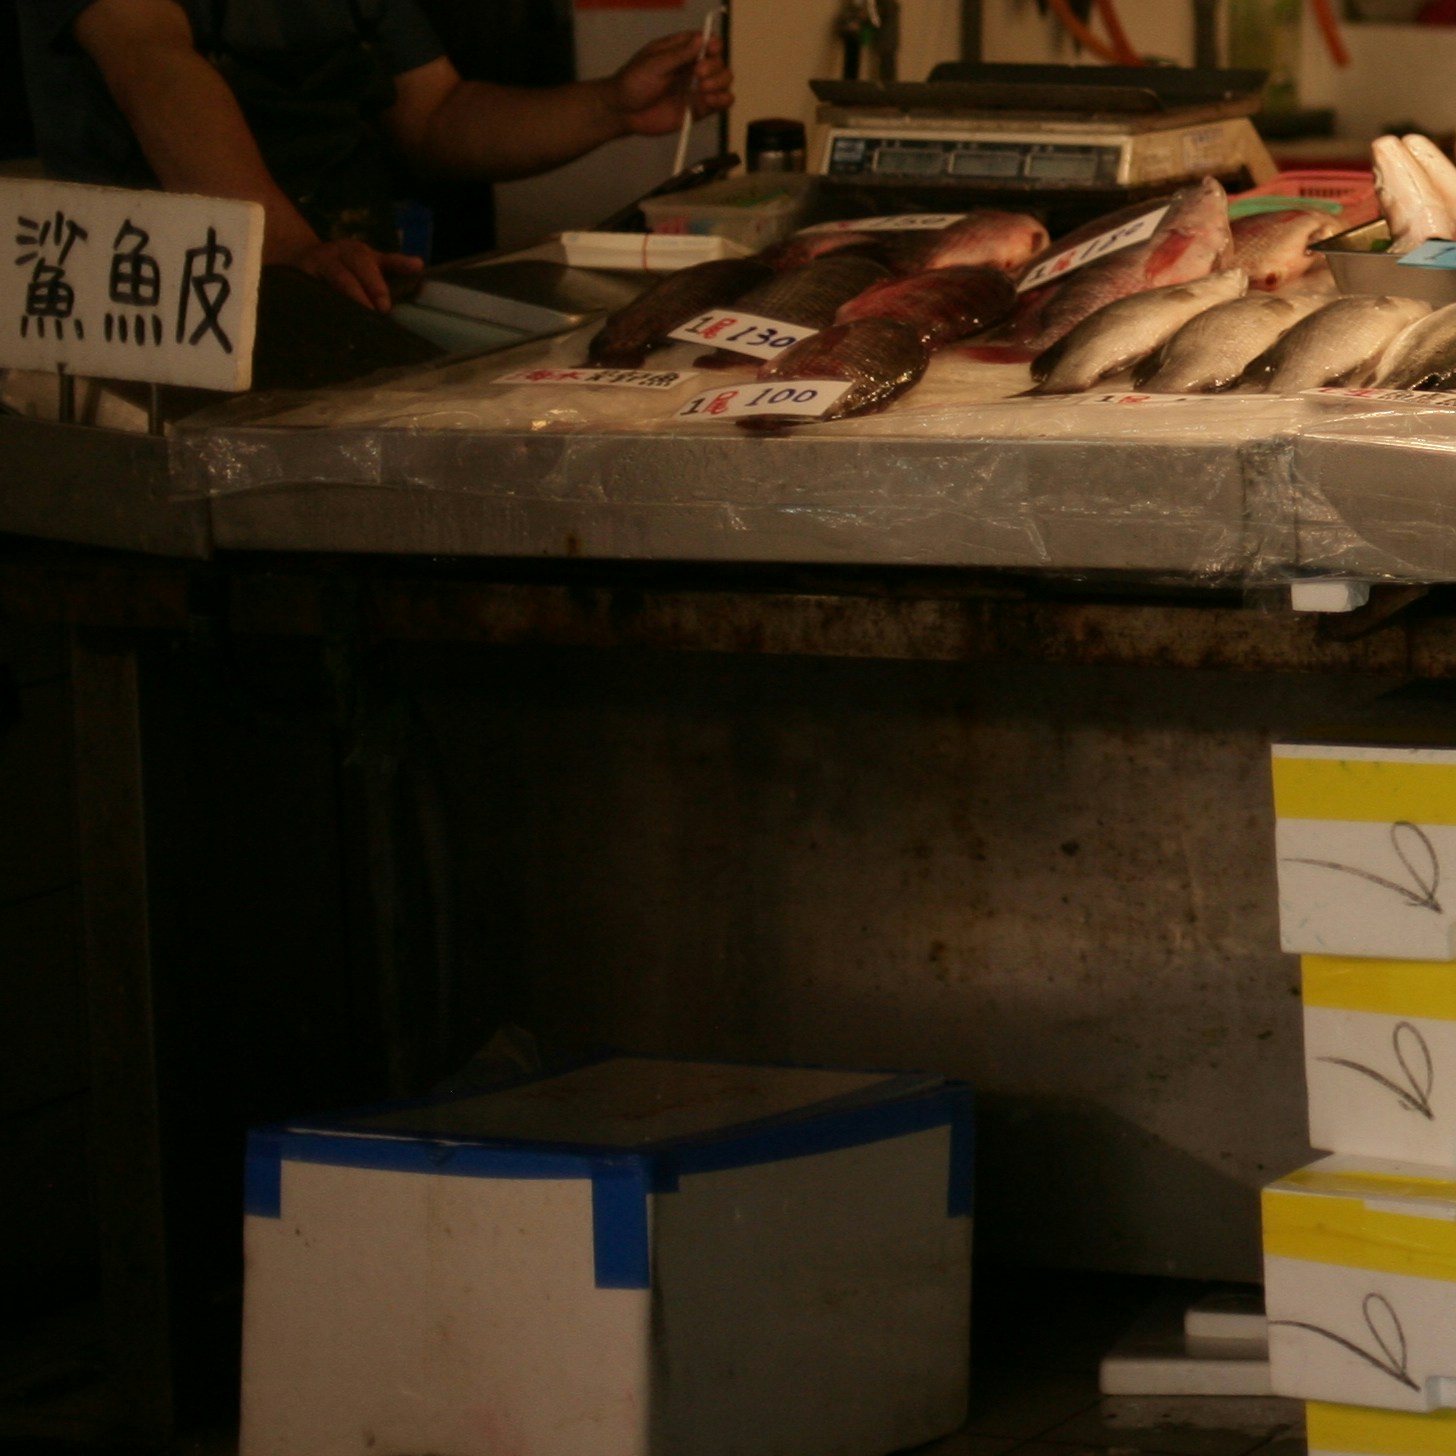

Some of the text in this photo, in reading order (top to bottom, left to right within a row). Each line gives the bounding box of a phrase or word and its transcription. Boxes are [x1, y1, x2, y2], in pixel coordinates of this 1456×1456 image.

[15, 210, 234, 355] 鯊魚皮
[684, 315, 799, 348] 1尾 130
[679, 388, 819, 416] 1尾 100
